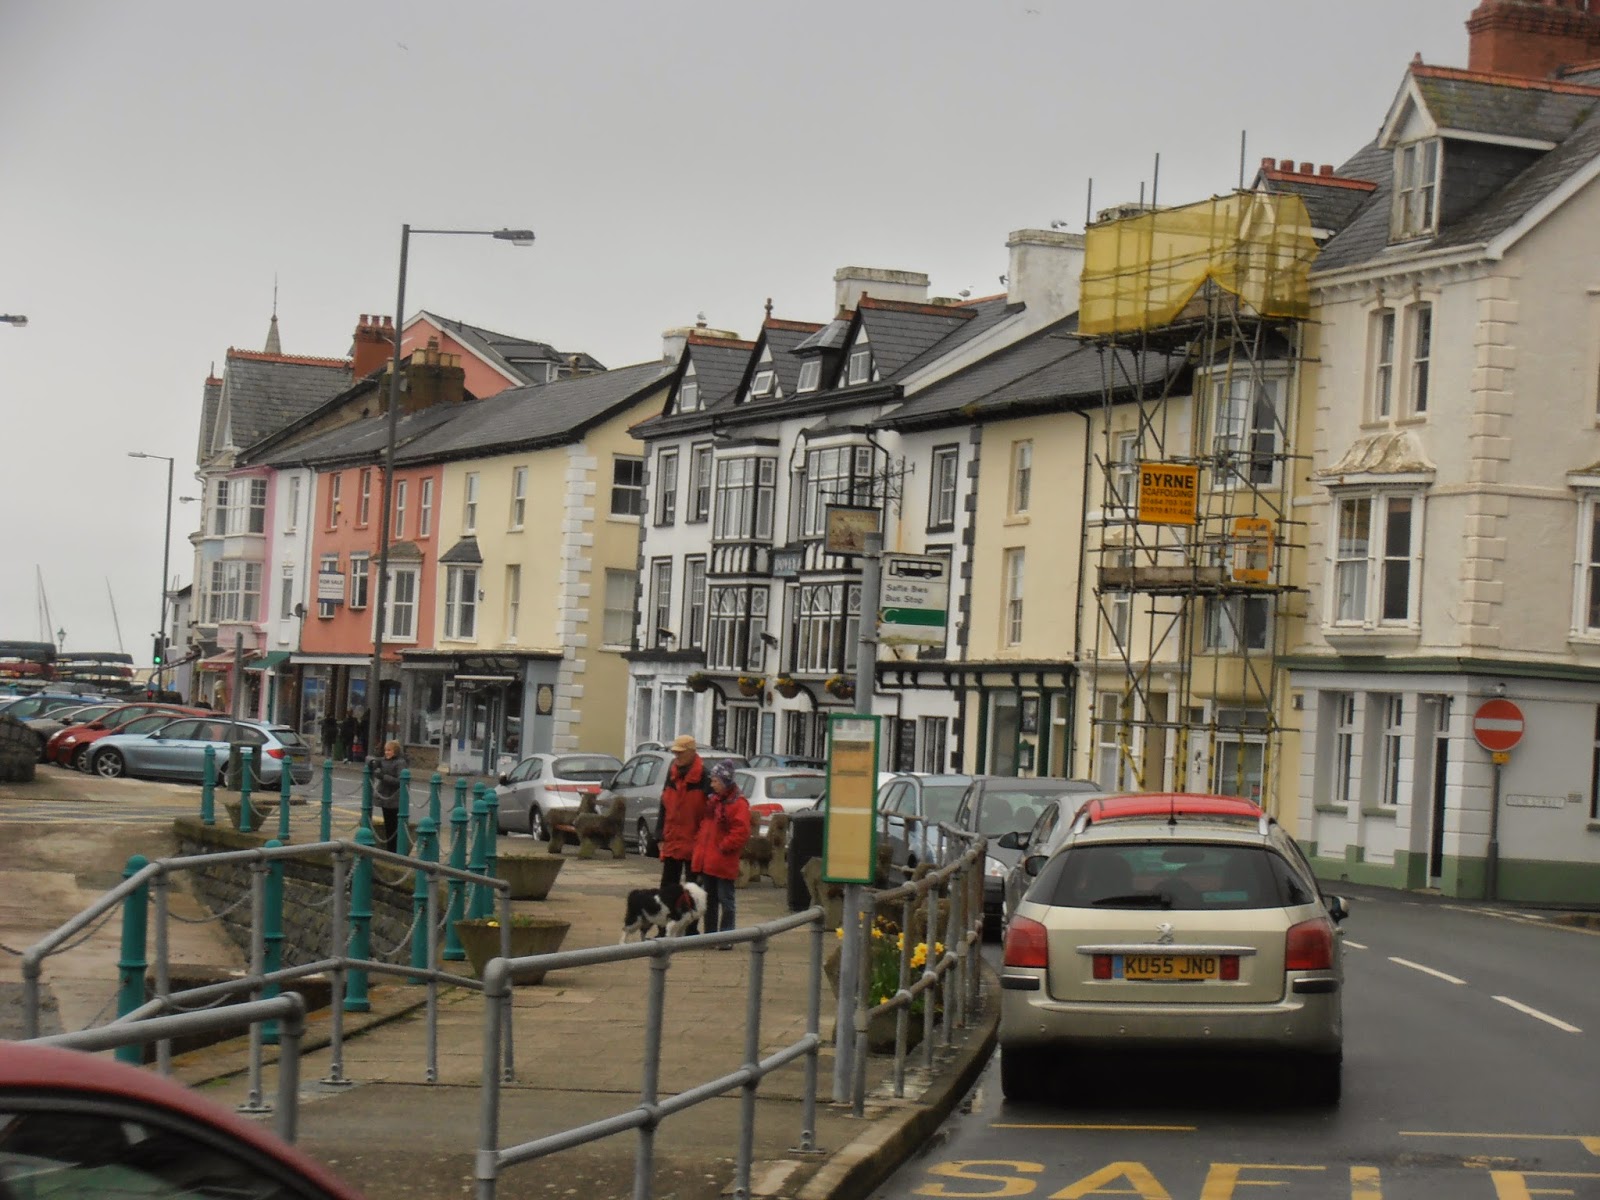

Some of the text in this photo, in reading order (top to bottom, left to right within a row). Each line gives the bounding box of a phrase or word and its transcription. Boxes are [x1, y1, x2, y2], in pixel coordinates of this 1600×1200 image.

[1143, 473, 1193, 489] BYRNE
[1142, 488, 1193, 498] SCAFFOLDING
[885, 594, 924, 605] Bus Stop
[1125, 957, 1216, 975] KU55 JNO
